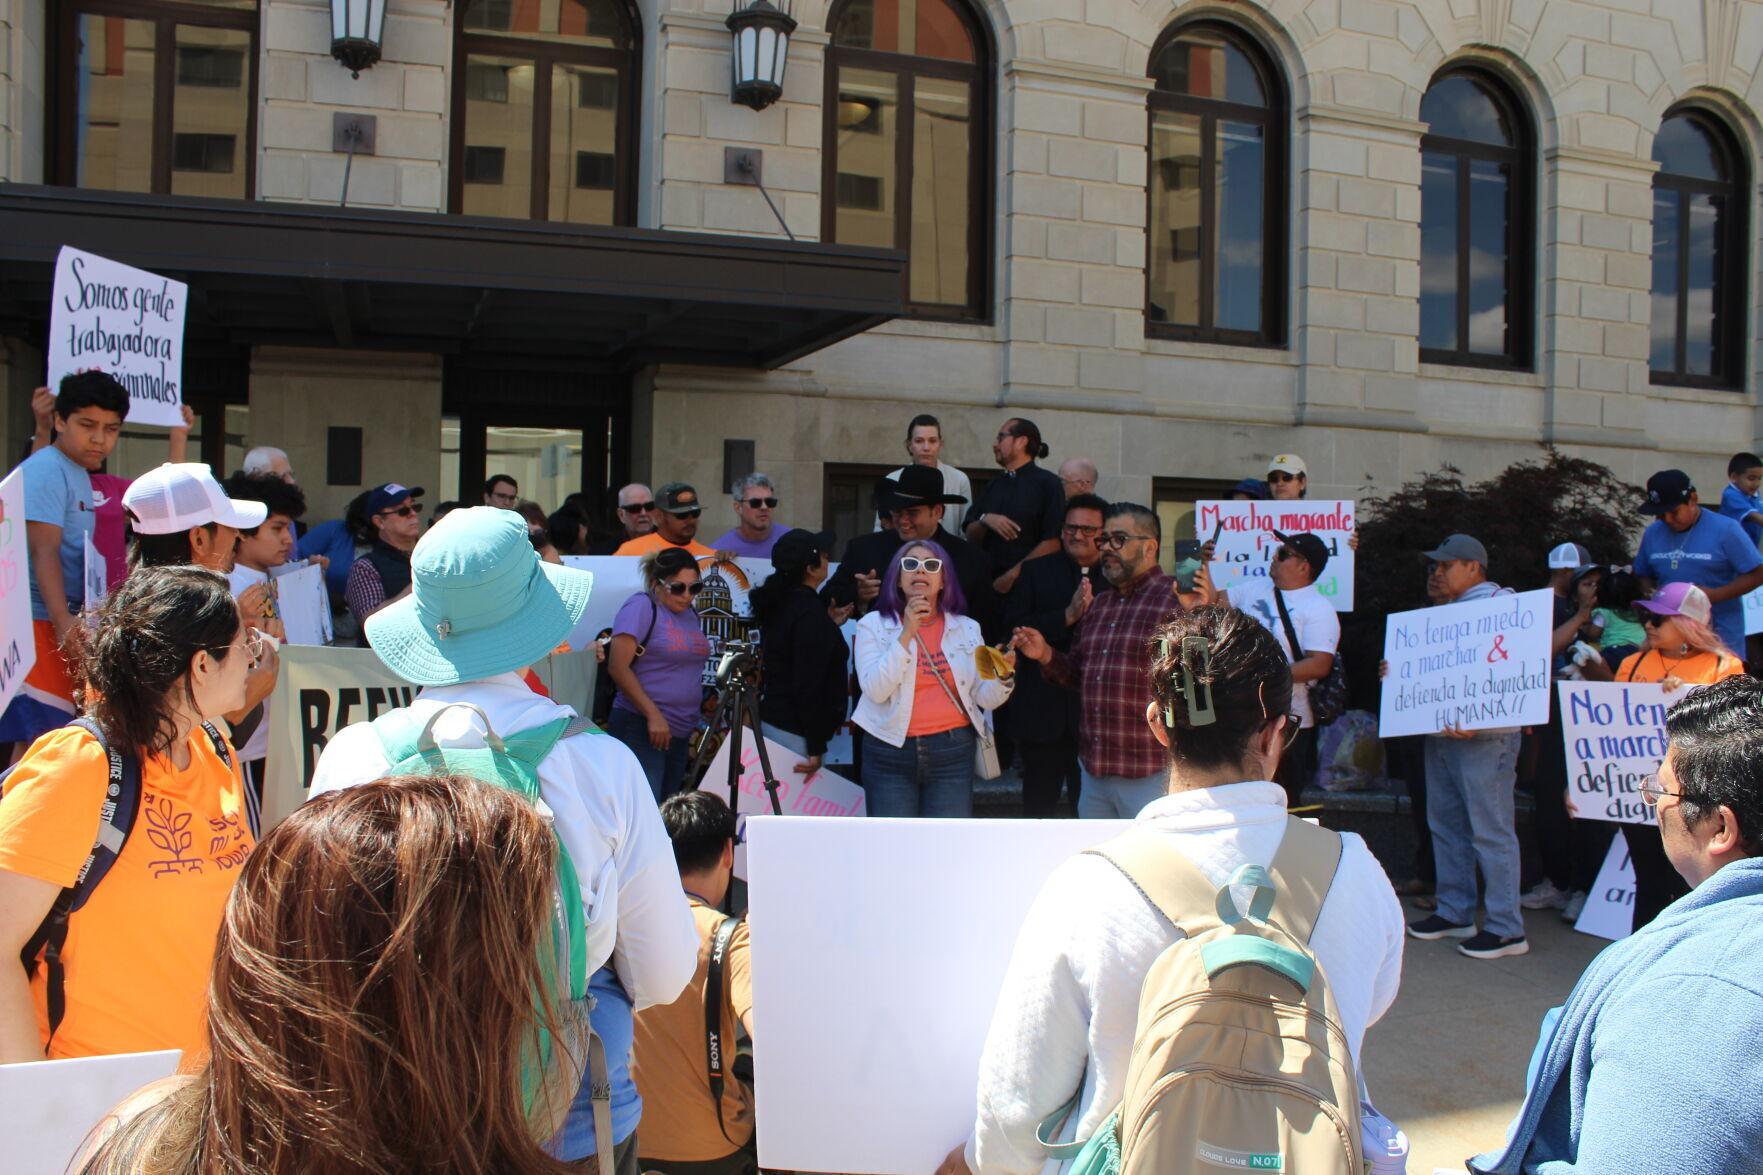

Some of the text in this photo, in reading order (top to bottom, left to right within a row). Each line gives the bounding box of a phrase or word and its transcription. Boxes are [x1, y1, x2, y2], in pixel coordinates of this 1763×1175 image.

[65, 257, 175, 326] Somos gente
[66, 316, 172, 367] trabajadora
[1201, 502, 1353, 536] Marcha migrante
[1395, 625, 1420, 651] No
[1477, 598, 1534, 636] miedo
[1400, 634, 1509, 679] a marchar &
[1394, 658, 1547, 712] defienda la dignidad
[1570, 688, 1613, 726] No
[1575, 738, 1595, 760] a
[710, 1032, 719, 1069] SONY
